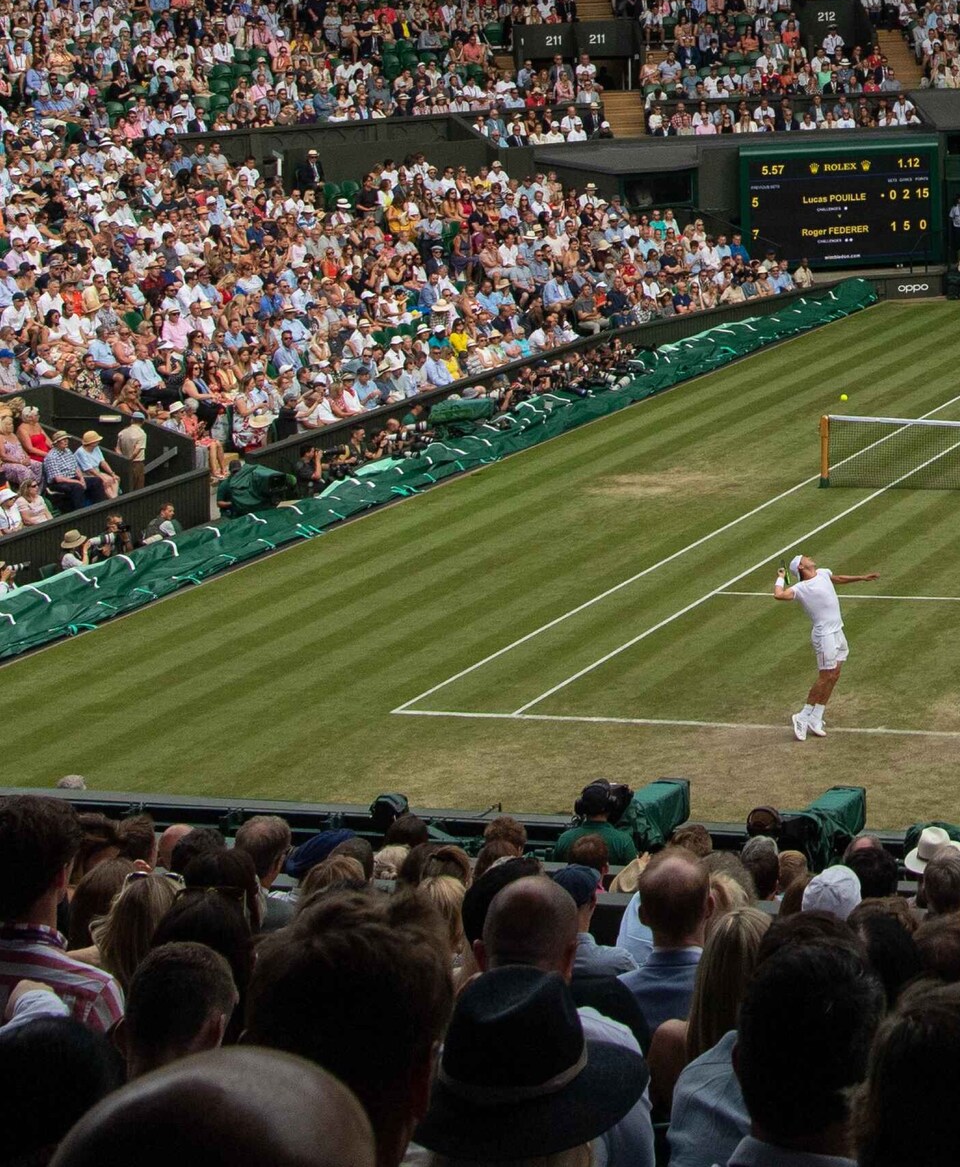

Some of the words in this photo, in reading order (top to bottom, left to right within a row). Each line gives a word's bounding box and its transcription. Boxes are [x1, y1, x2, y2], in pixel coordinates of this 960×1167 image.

[817, 11, 836, 22] 212
[545, 35, 562, 46] 211
[589, 34, 606, 44] 211
[823, 162, 858, 172] ROLEX
[897, 157, 920, 169] 1.12
[761, 165, 785, 176] 5.57
[802, 195, 828, 204] Lucas
[829, 192, 867, 203] POUILLE
[889, 189, 897, 200] 0
[902, 188, 911, 199] 2
[915, 187, 930, 199] 15
[751, 196, 759, 208] 5
[890, 220, 897, 232] 1
[903, 220, 911, 231] 5
[919, 218, 927, 230] 0
[801, 228, 827, 238] Roger
[828, 224, 869, 235] FEDERER
[897, 283, 929, 294] oppo
